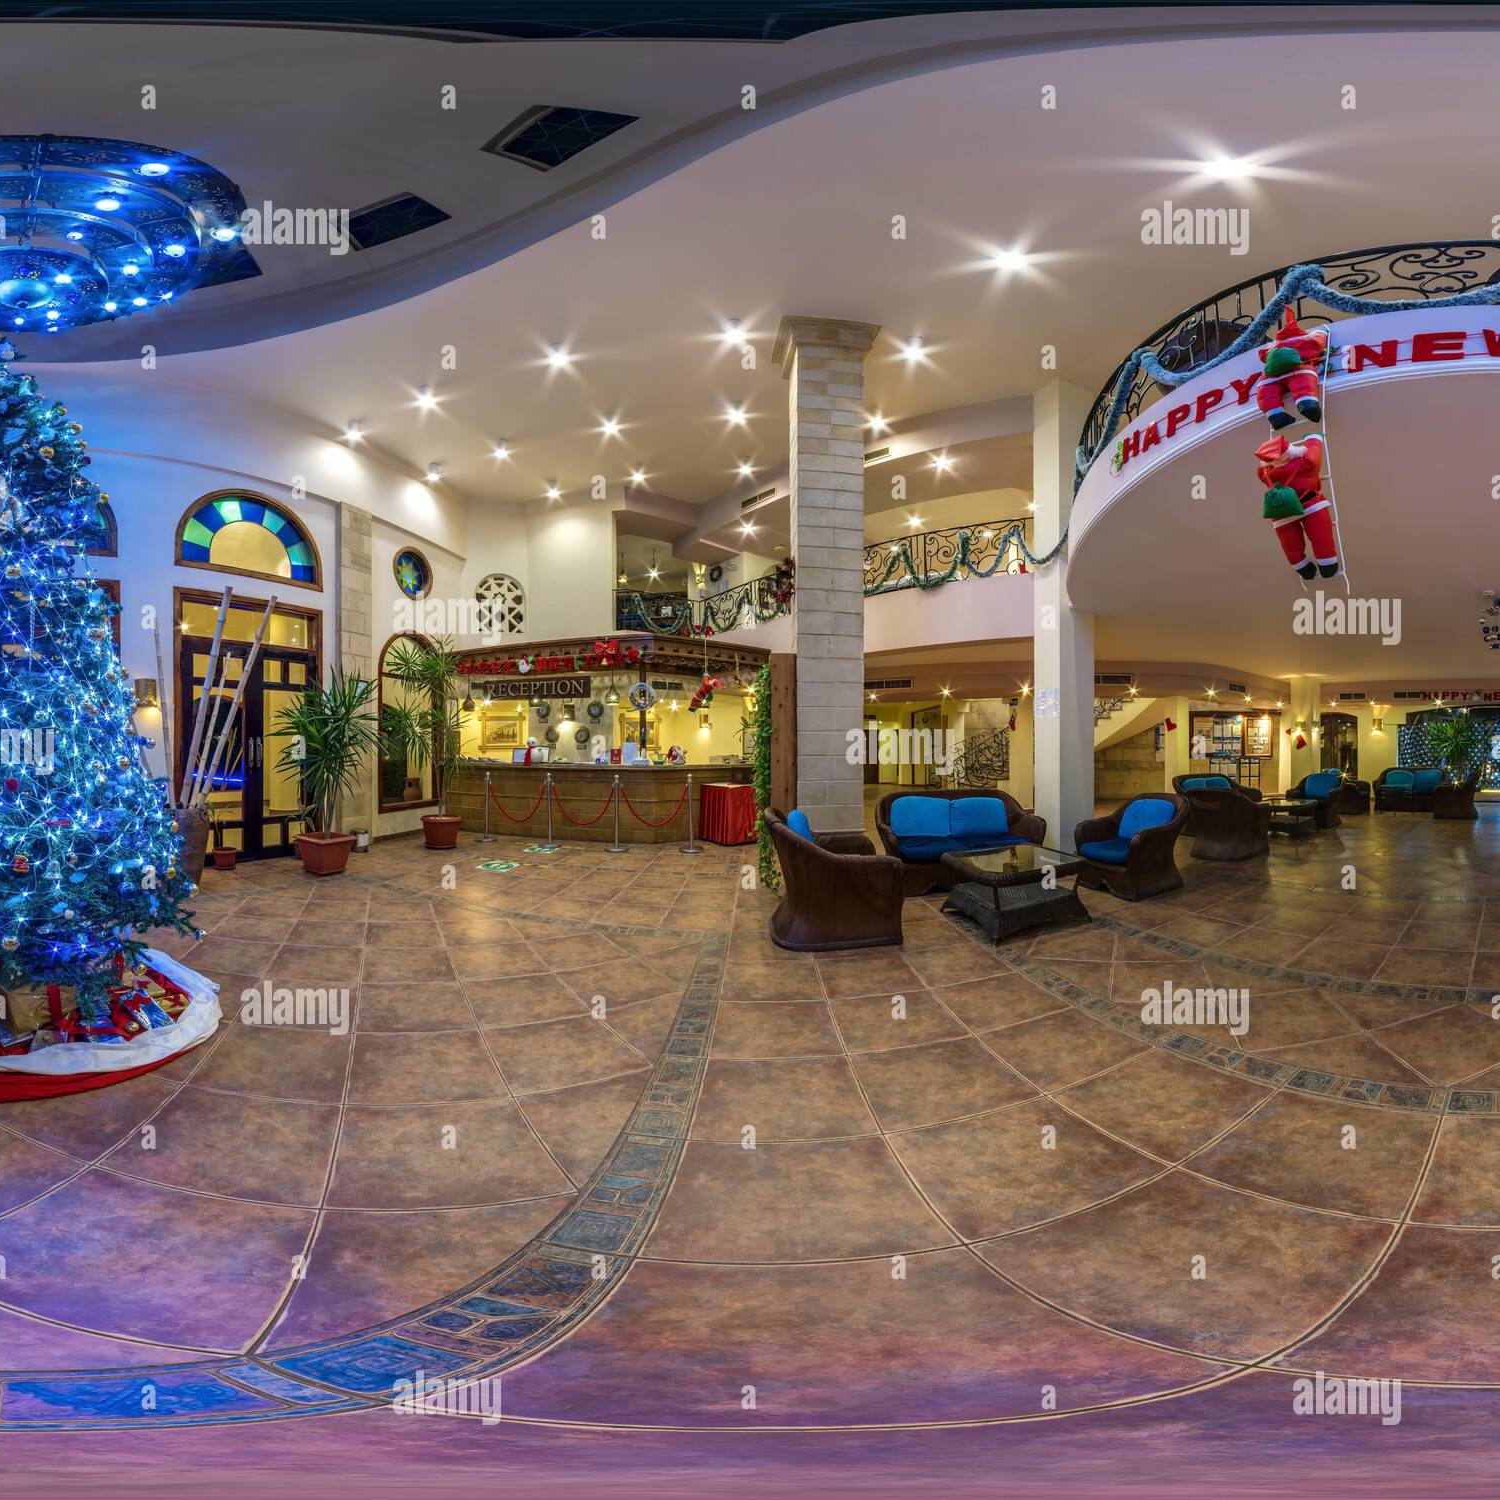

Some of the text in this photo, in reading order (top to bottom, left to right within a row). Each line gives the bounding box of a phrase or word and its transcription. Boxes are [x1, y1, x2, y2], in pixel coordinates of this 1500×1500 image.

[1122, 371, 1263, 464] HAPPY
[487, 679, 585, 698] RECEPTION
[1423, 691, 1468, 700] HAPPY
